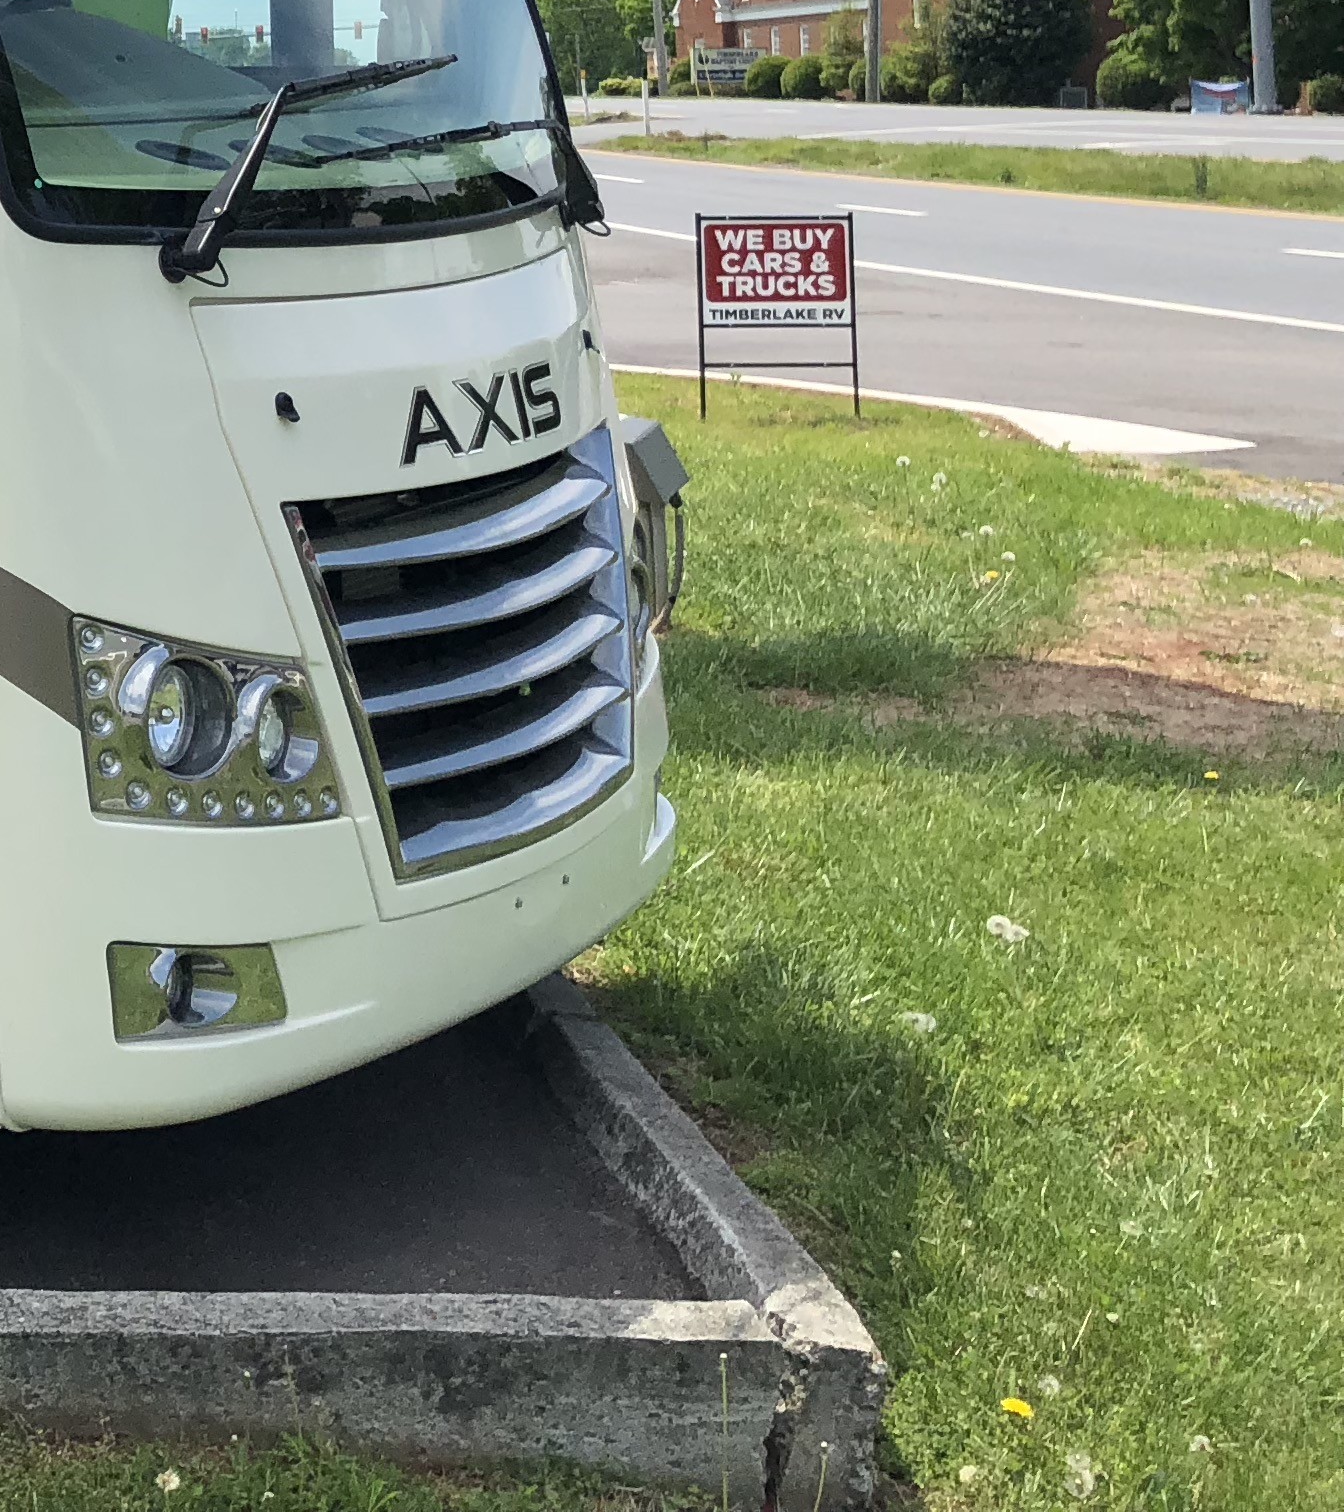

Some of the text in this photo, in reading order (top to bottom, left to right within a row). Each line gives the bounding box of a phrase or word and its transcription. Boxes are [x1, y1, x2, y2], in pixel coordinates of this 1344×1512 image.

[714, 228, 835, 251] WE BUY
[720, 252, 830, 274] CARS &
[716, 275, 836, 297] TRUCKS
[709, 308, 846, 321] TIMBERLAKE RV
[399, 360, 562, 468] AXIS
